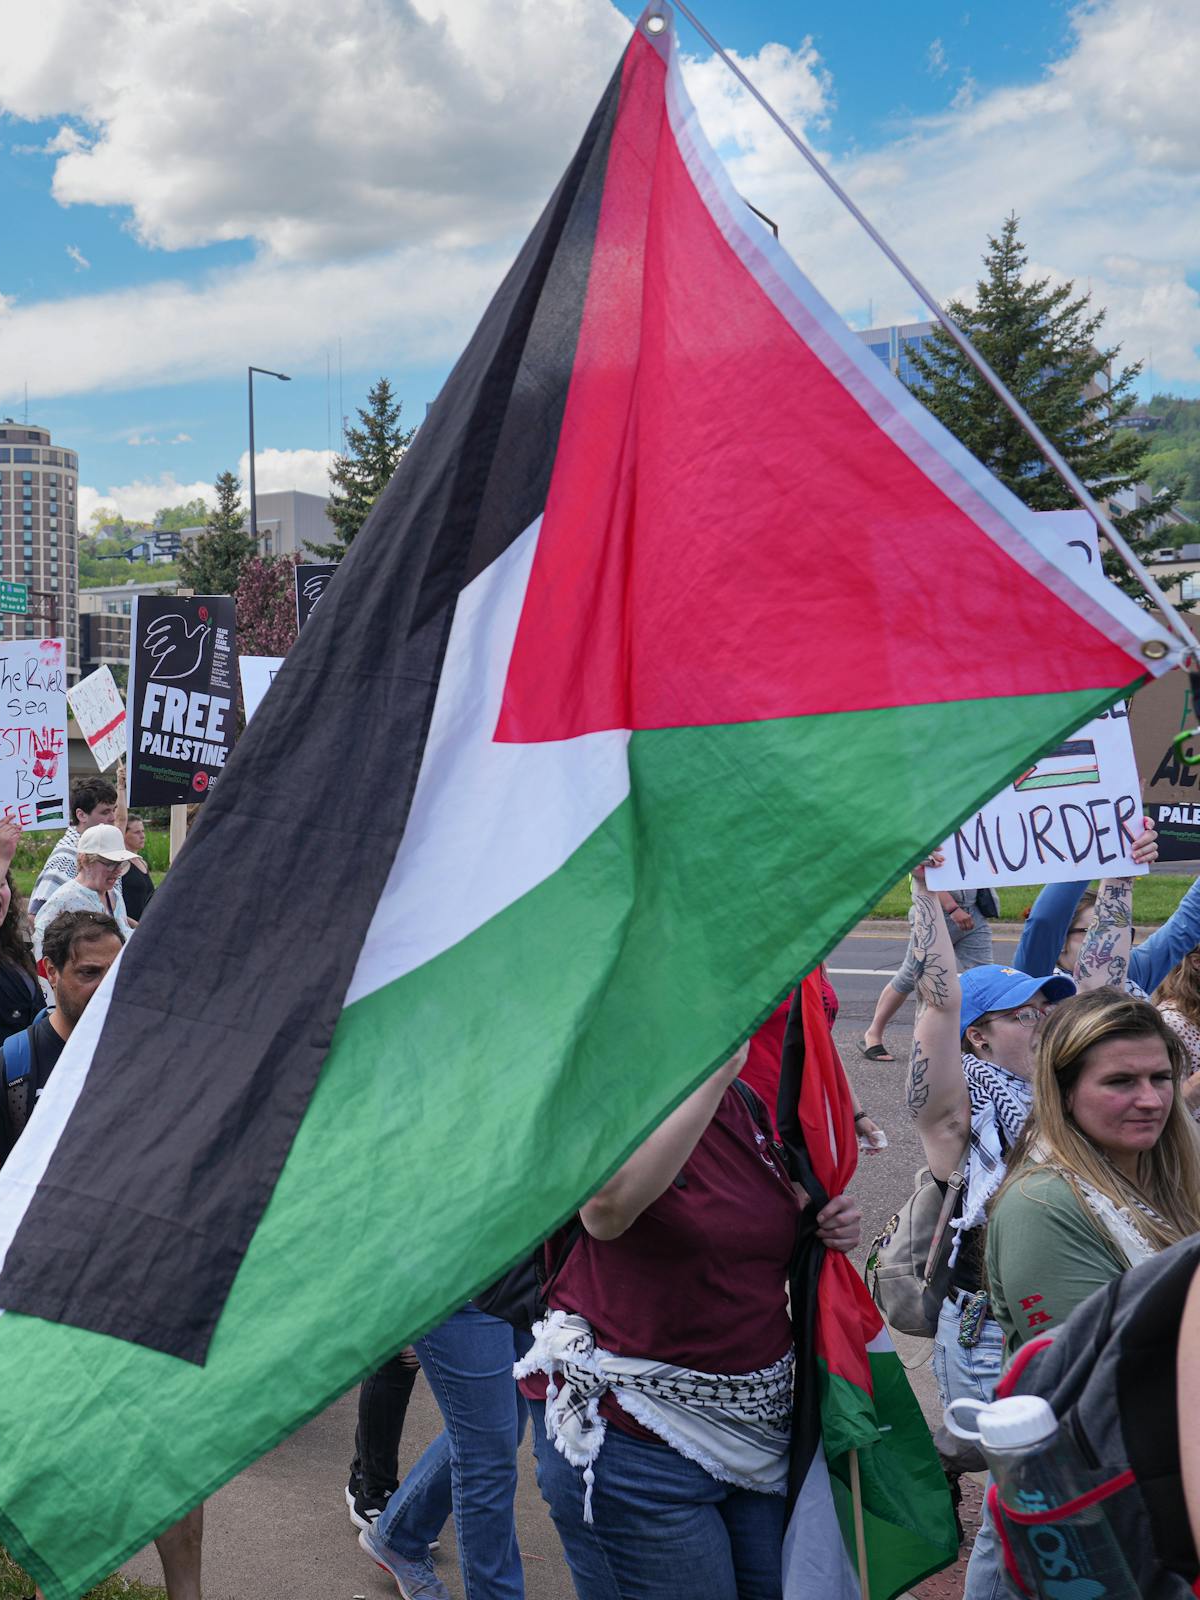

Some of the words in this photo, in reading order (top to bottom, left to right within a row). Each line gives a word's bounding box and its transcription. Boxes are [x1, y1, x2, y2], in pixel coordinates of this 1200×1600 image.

[140, 681, 230, 743] FREE
[140, 731, 228, 768] PALESTINE
[954, 795, 1136, 880] MURDER
